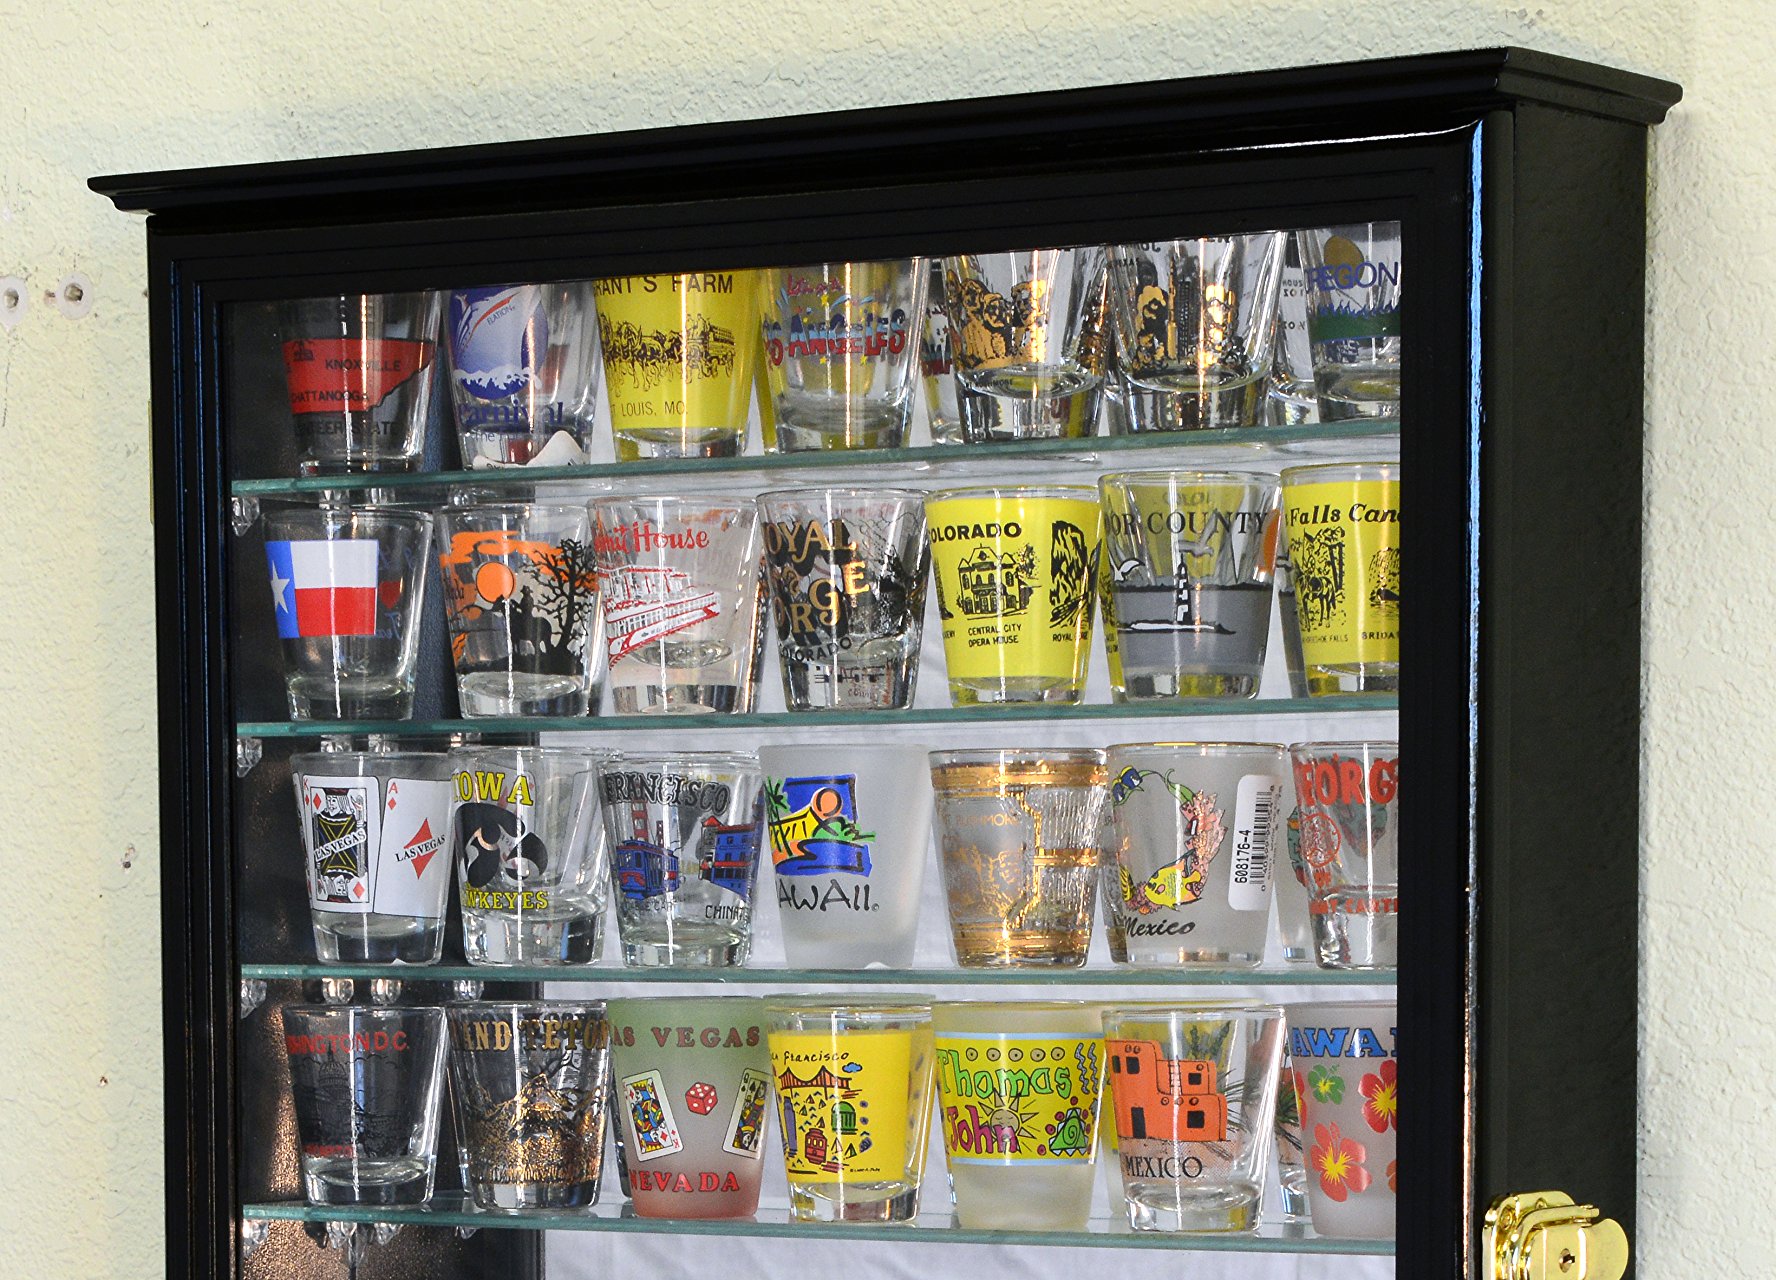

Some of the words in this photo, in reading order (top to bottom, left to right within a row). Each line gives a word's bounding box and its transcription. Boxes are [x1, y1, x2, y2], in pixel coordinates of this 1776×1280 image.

[1147, 509, 1269, 535] COUNTY
[1290, 504, 1341, 527] Falls
[1348, 503, 1400, 523] Can
[632, 520, 710, 553] House
[1003, 623, 1022, 633] CITY
[1361, 631, 1400, 641] BRIDA
[968, 637, 991, 648] OPERA
[388, 781, 398, 794] A
[315, 845, 332, 860] LAS
[332, 830, 367, 852] VEGAS
[395, 846, 416, 862] LAS
[417, 834, 446, 855] VEGAS
[1234, 829, 1251, 884] 608176-4
[1124, 916, 1196, 937] Mexico
[651, 1026, 760, 1047] VEGAS
[1292, 1026, 1397, 1058] AWA
[936, 1048, 1073, 1099] Thomas
[947, 1104, 1022, 1155] John
[1125, 1155, 1204, 1179] MEXICO
[629, 1168, 740, 1193] NEVADA
